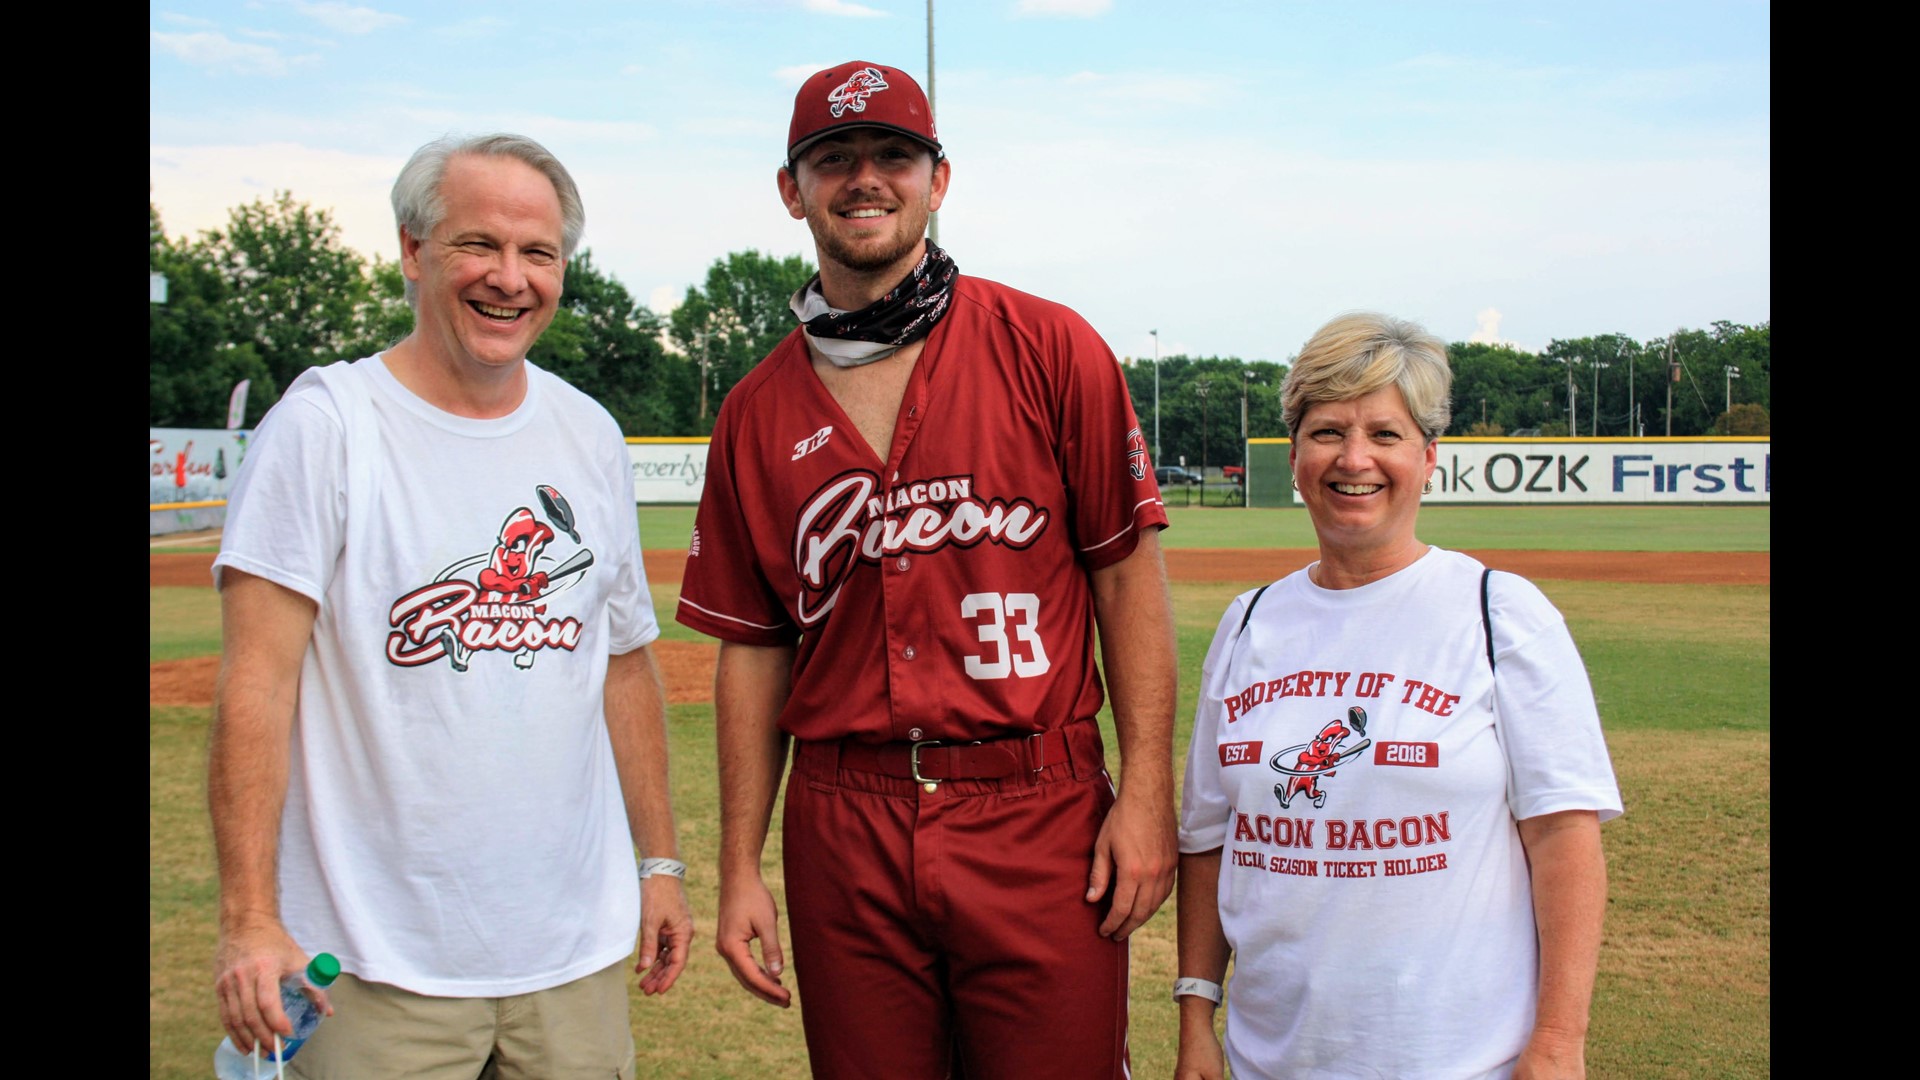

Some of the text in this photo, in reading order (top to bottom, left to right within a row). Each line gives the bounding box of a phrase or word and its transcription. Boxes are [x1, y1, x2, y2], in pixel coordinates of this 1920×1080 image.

[632, 453, 702, 486] everly
[1436, 453, 1590, 493] nk OZK
[1612, 454, 1756, 493] First
[866, 479, 970, 519] MACON
[794, 473, 1047, 625] Bacon
[387, 580, 583, 666] Bacon
[470, 604, 535, 619] MACON
[961, 592, 1050, 680] 33
[1224, 671, 1461, 723] PROPERTY OF THE
[1225, 744, 1426, 763] EST. 2018
[1234, 811, 1451, 850] ACON BACON
[1232, 850, 1448, 878] FICIAL SEASON TICKET HOLDER
